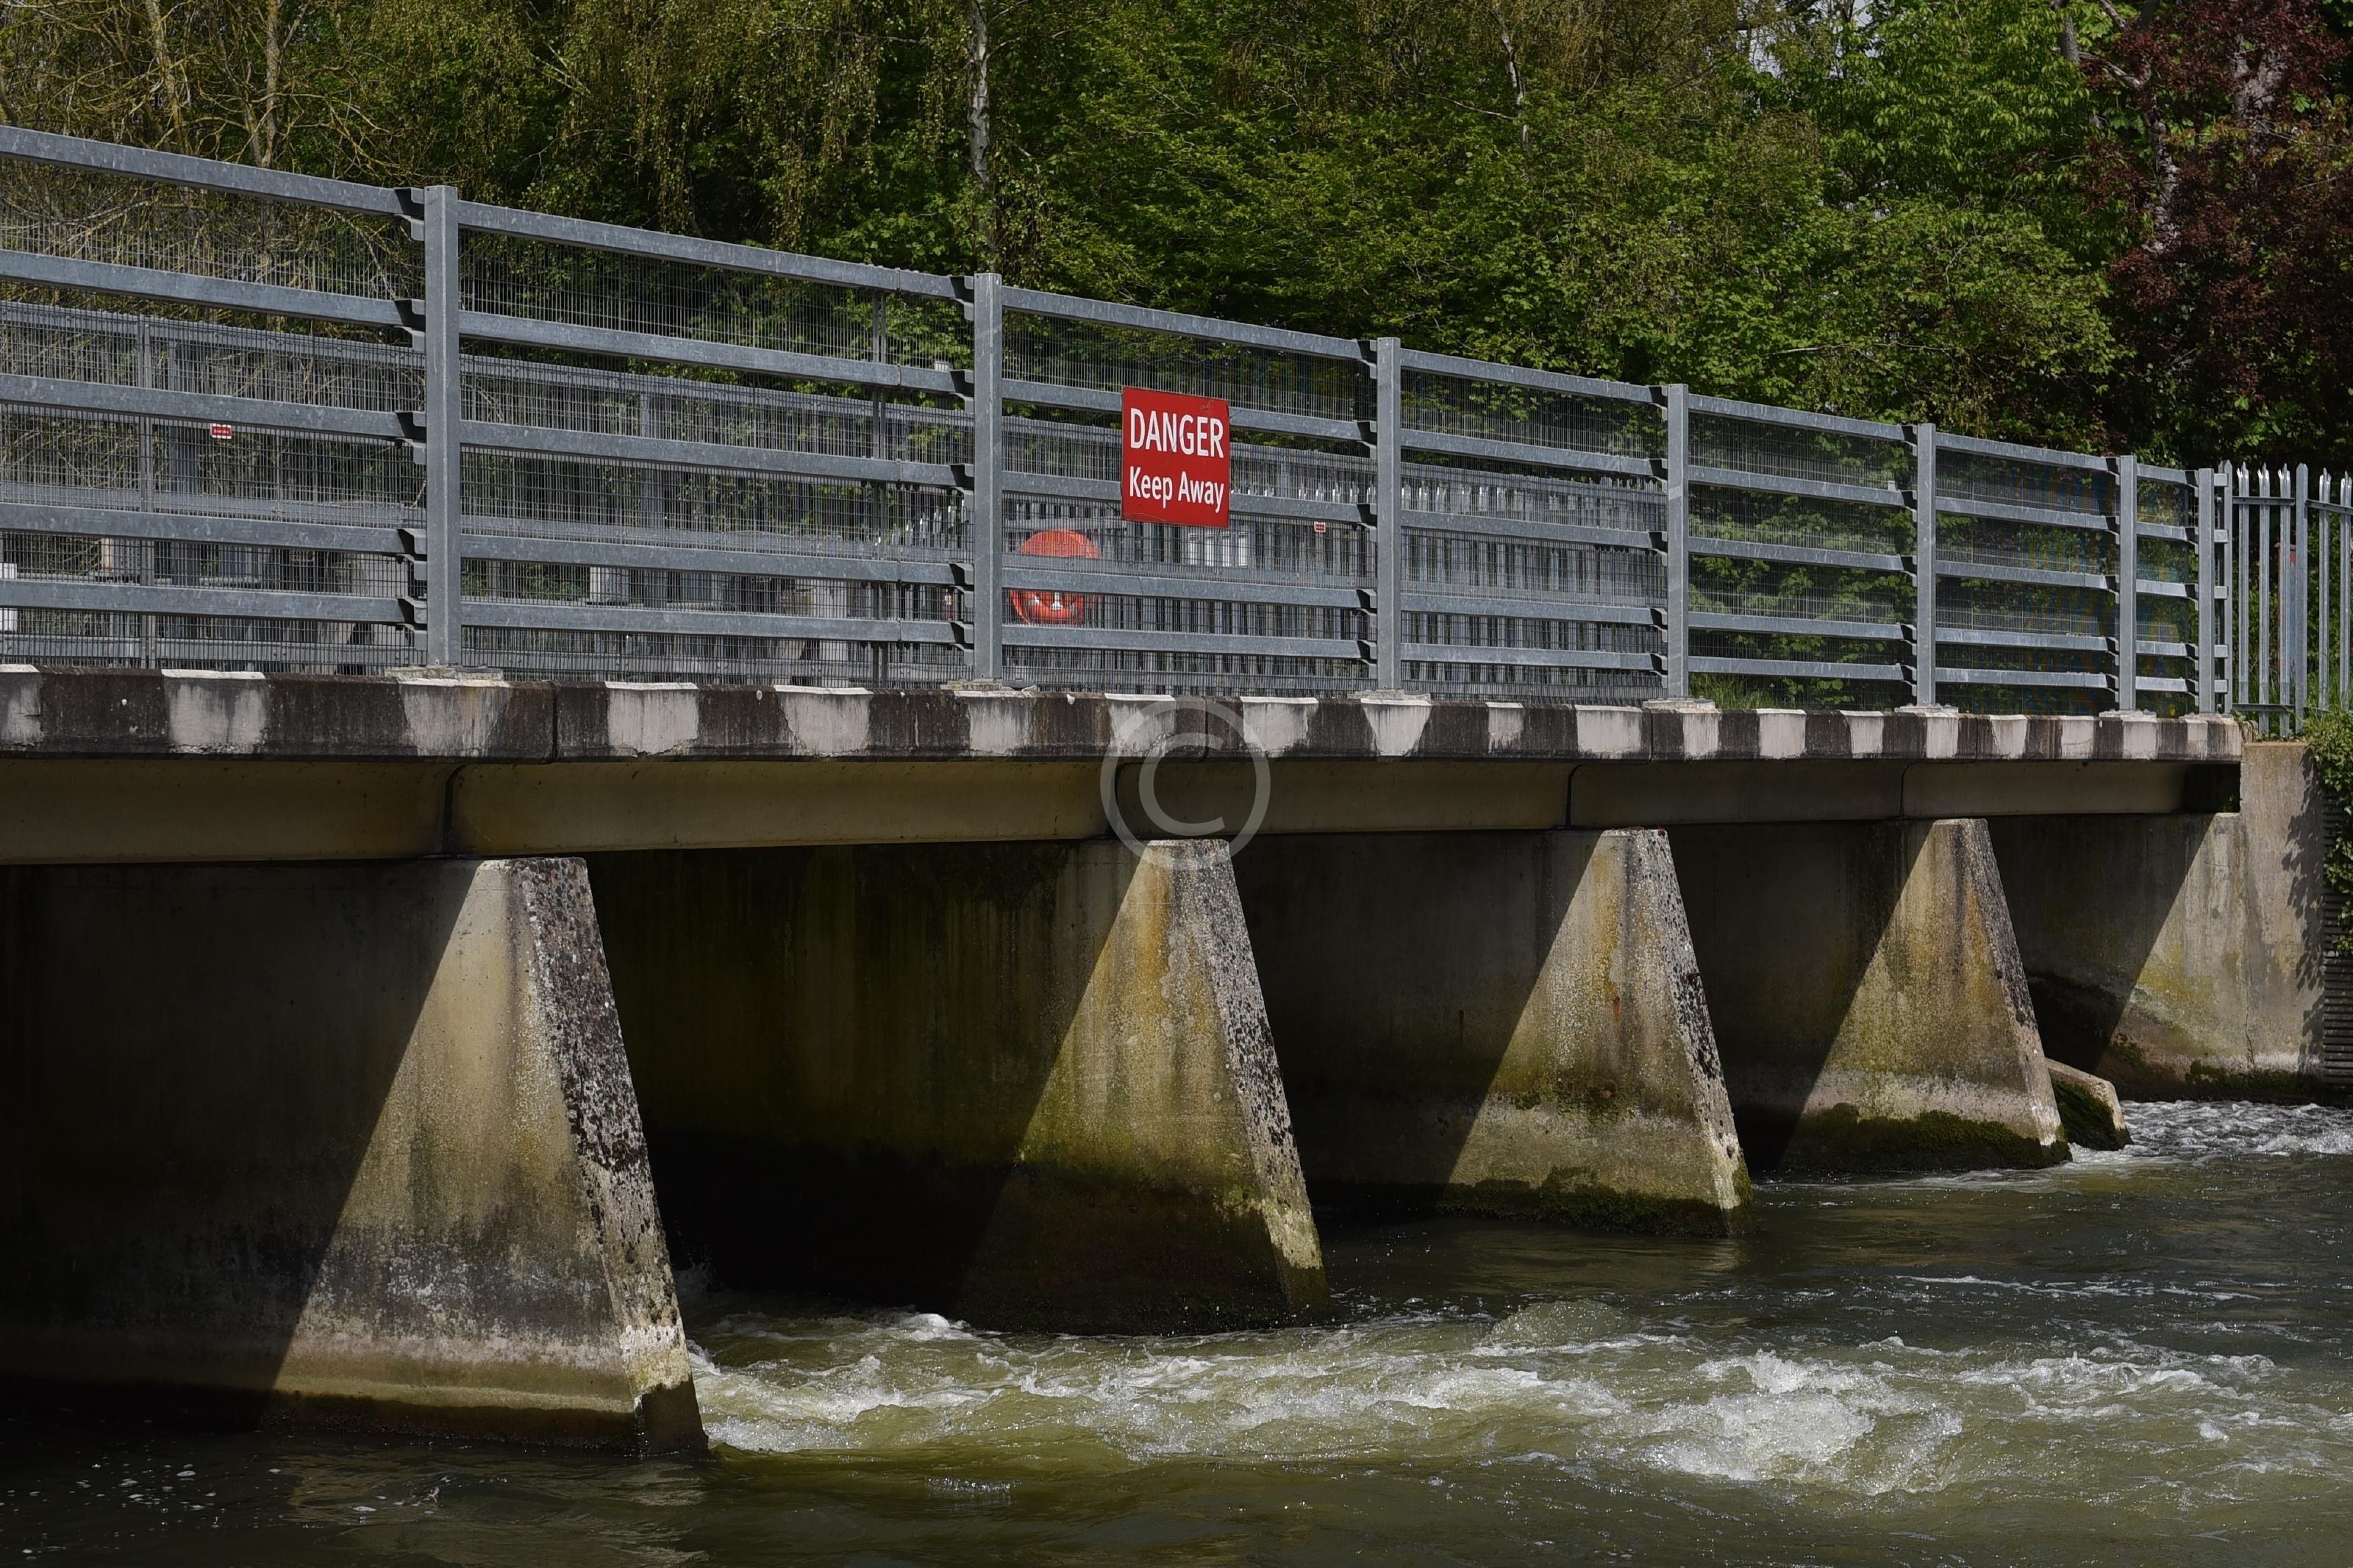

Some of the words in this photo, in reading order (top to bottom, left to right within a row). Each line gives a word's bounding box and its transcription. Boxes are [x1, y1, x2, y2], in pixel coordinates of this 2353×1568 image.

[1130, 407, 1224, 458] DANGER
[1130, 466, 1172, 509] Keep
[1178, 471, 1224, 512] Away
